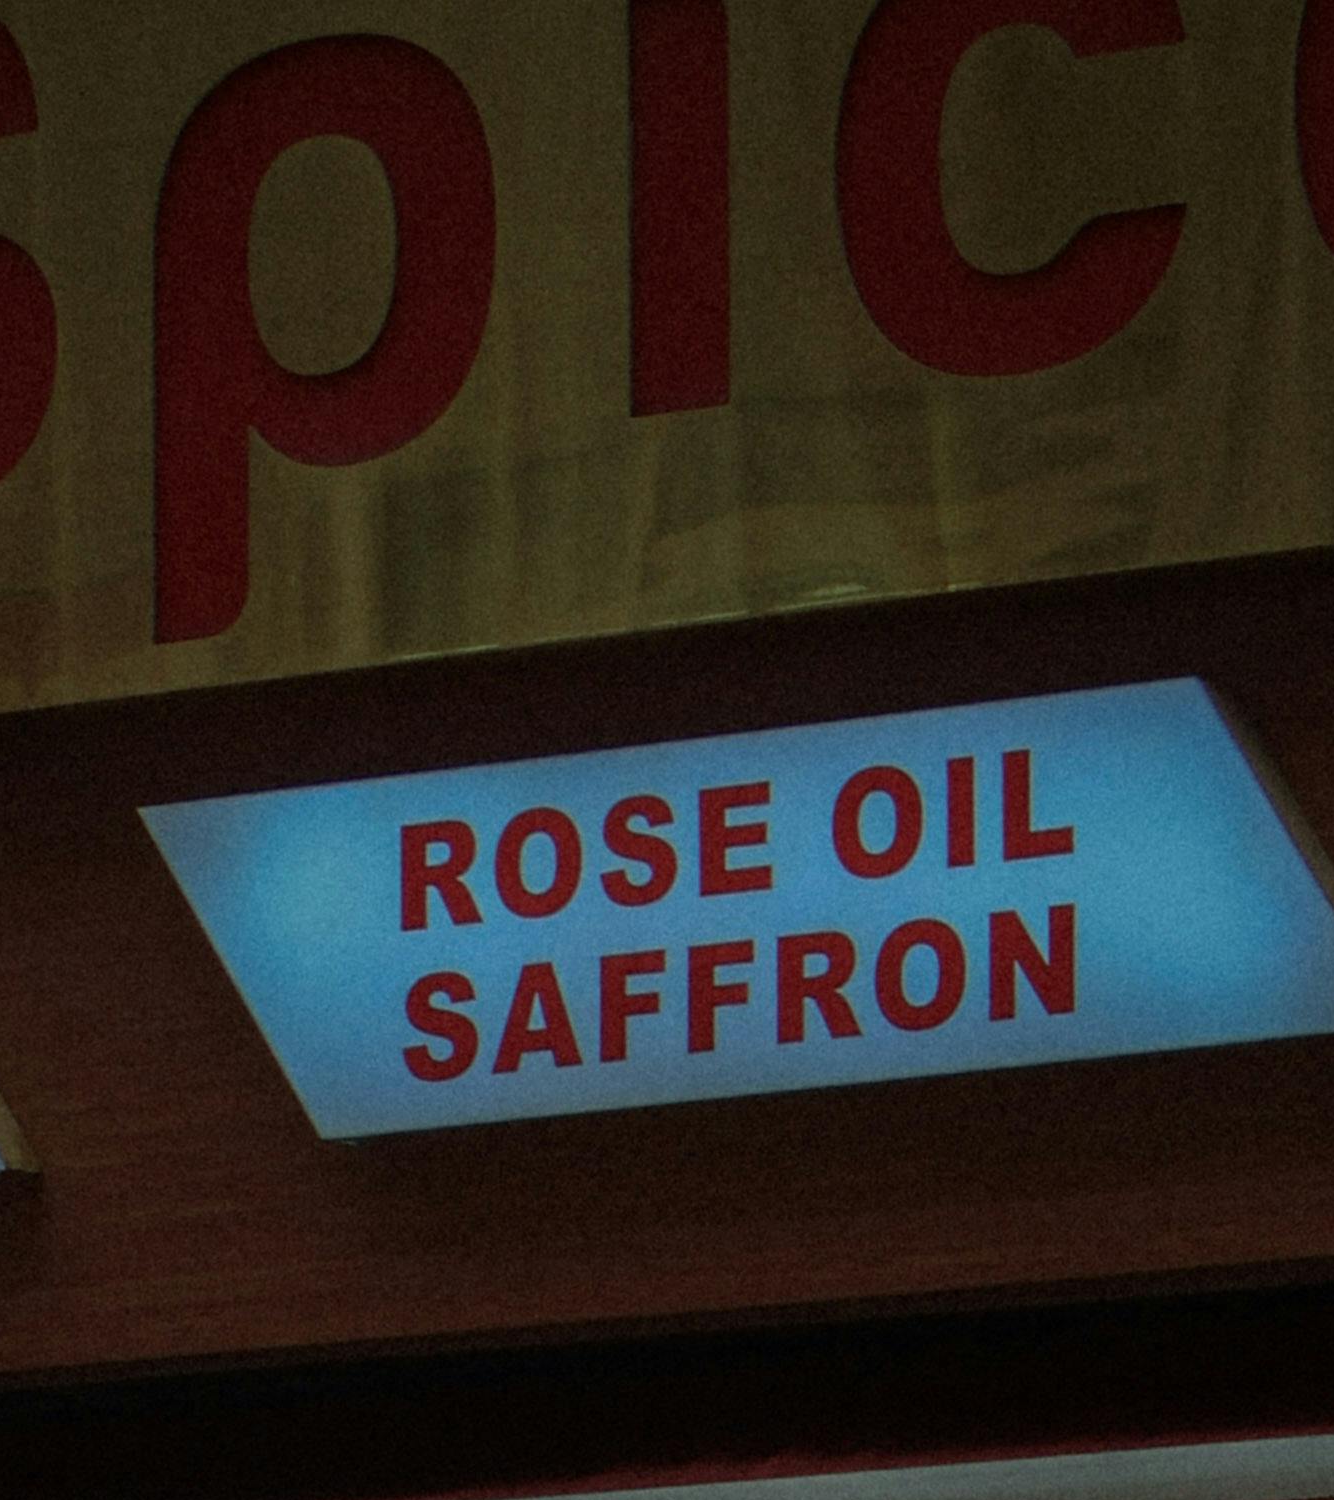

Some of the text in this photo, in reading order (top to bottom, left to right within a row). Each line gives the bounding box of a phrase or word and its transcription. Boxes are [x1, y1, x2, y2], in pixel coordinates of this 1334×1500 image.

[404, 751, 1074, 930] ROSE OIL
[406, 906, 1076, 1082] SAFFRON
